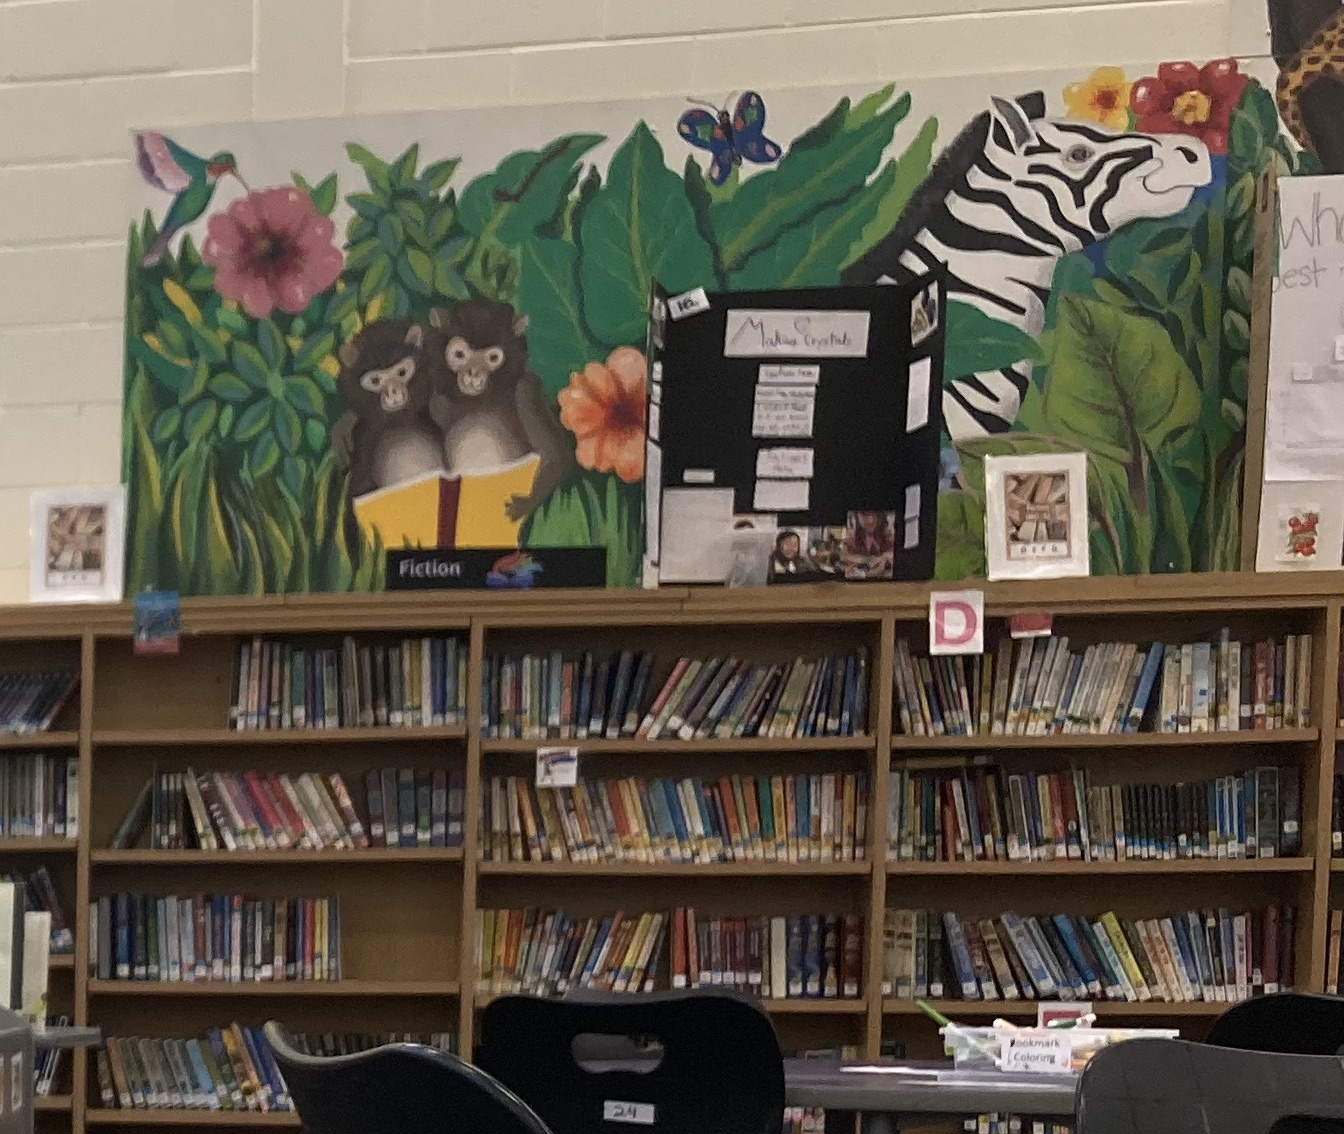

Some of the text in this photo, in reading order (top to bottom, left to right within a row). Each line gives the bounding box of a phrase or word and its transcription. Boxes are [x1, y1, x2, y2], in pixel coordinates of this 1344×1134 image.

[399, 557, 461, 578] Fiction
[935, 601, 978, 645] D
[613, 1104, 637, 1119] 24
